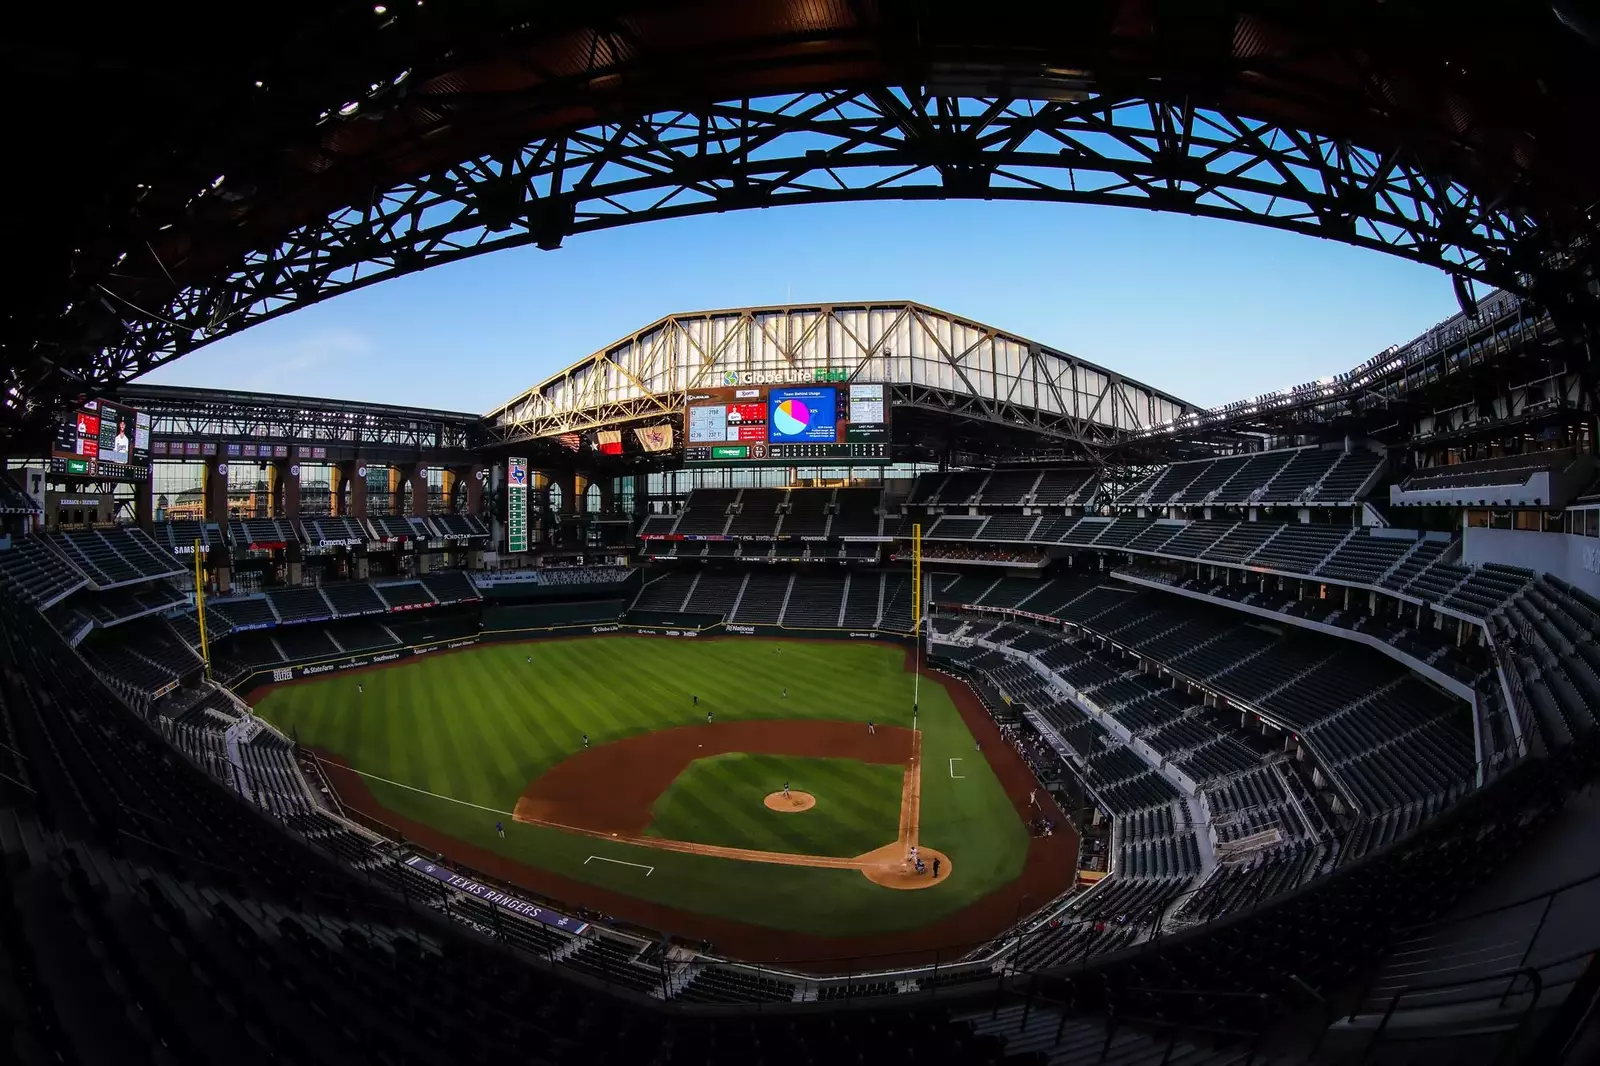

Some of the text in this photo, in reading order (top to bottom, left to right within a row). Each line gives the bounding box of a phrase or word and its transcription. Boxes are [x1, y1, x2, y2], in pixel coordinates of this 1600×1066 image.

[742, 366, 848, 385] Globe Life Field
[347, 537, 362, 546] Bank
[373, 653, 397, 662] Southwest
[273, 670, 293, 682] SELTZER
[446, 874, 543, 918] TEXAS RANGERS
